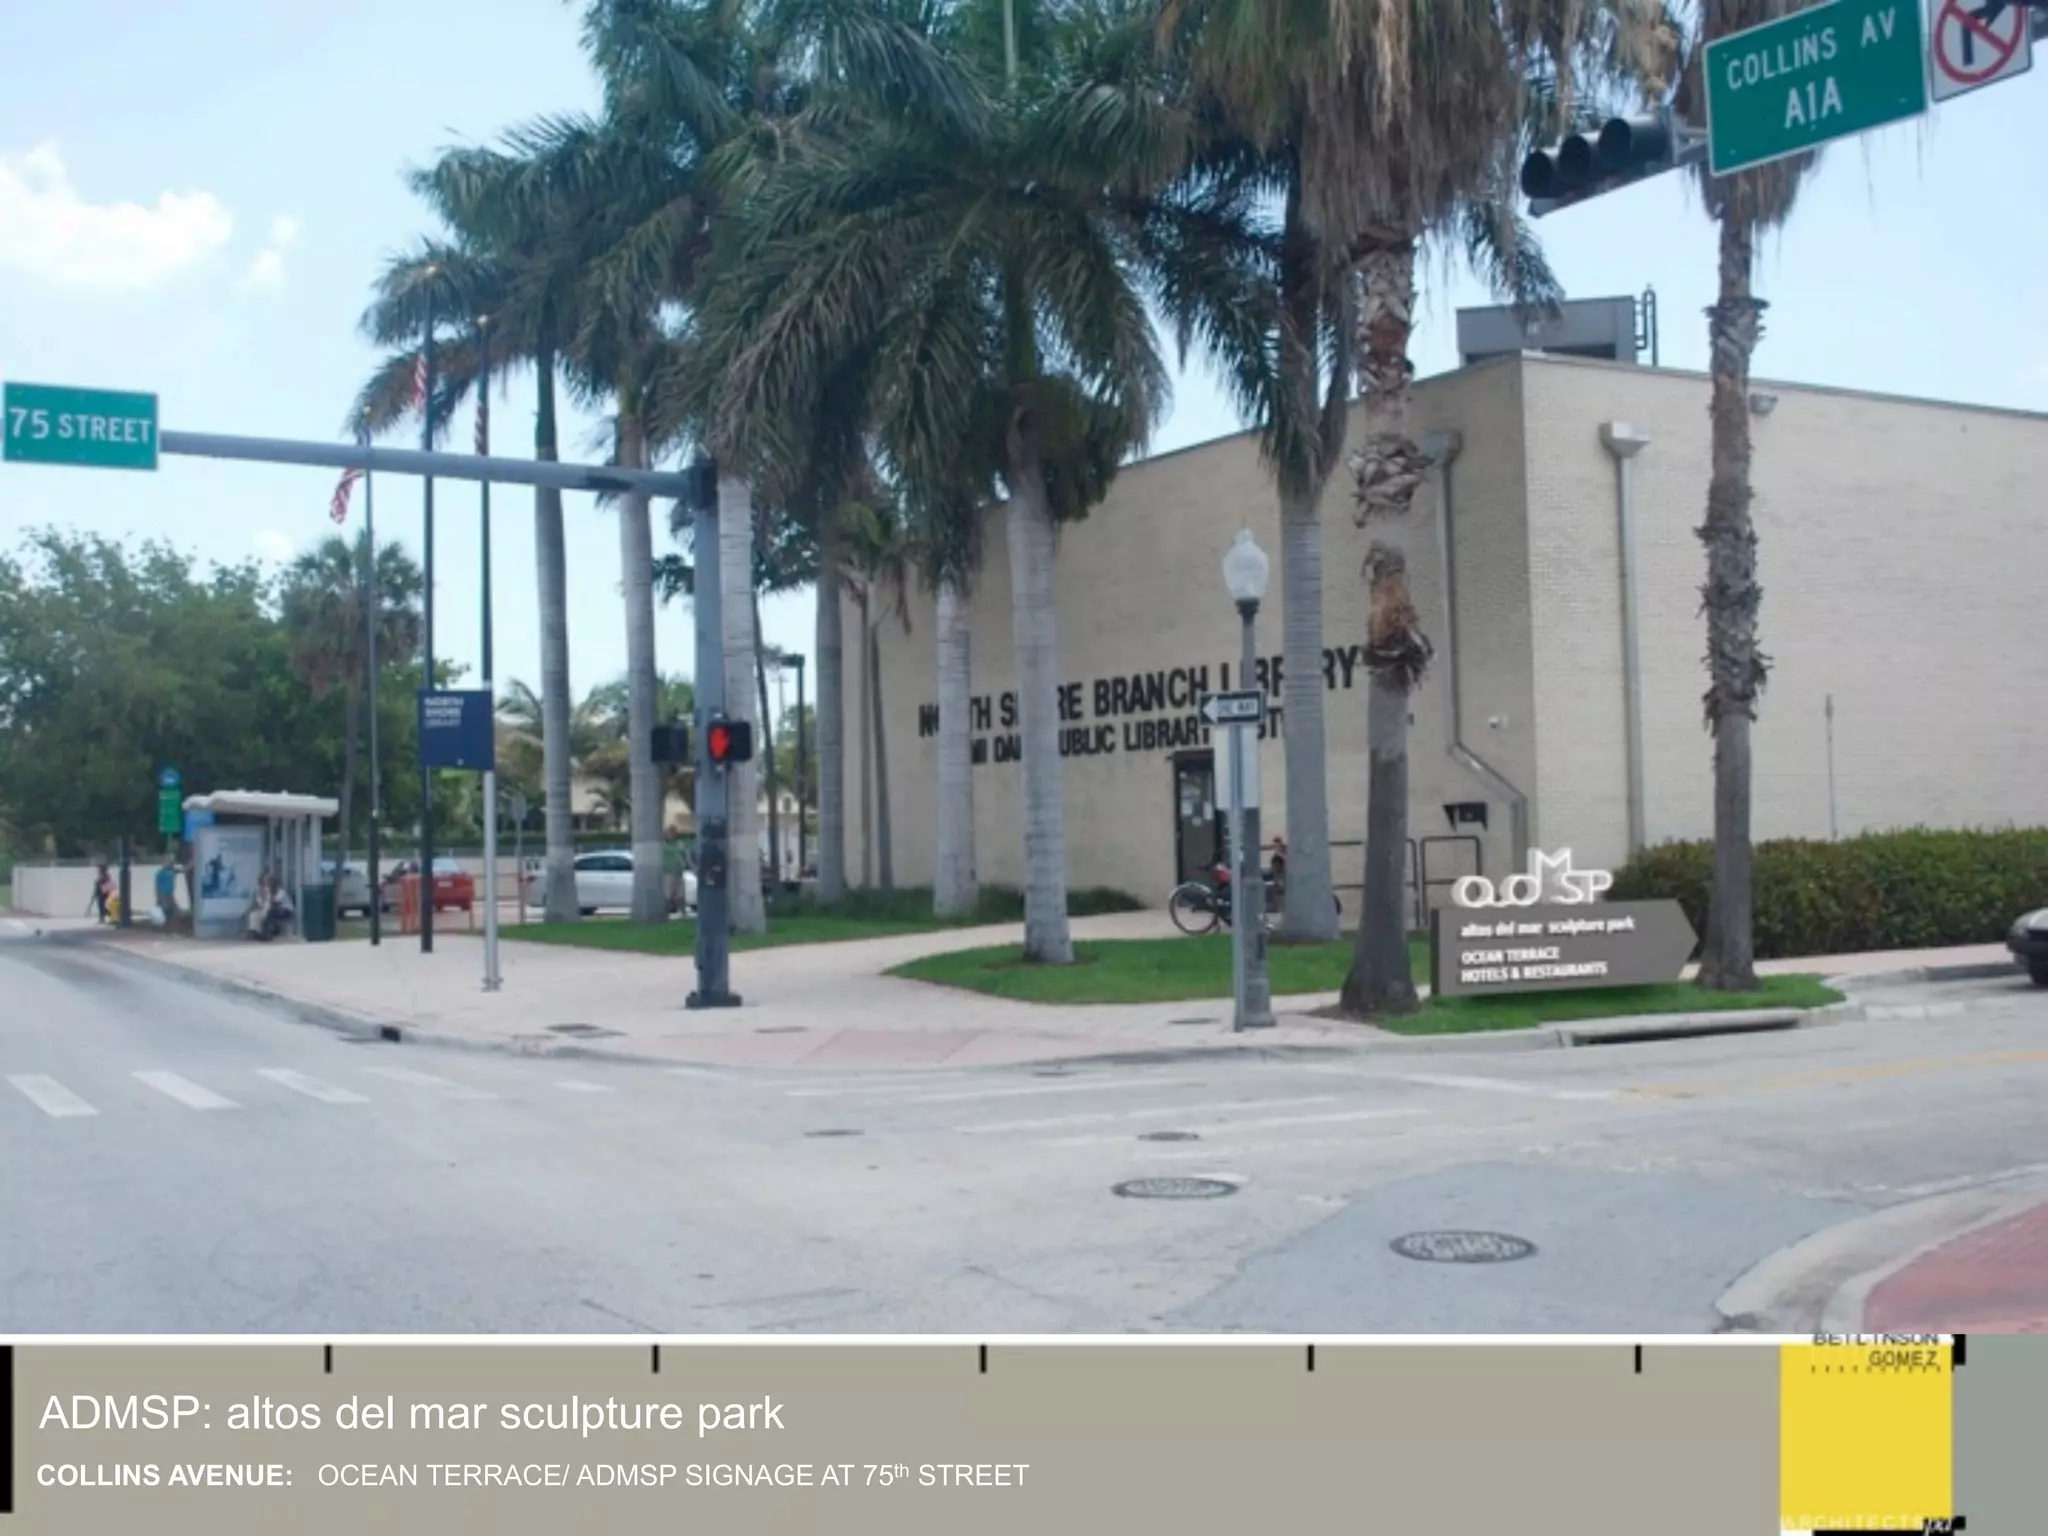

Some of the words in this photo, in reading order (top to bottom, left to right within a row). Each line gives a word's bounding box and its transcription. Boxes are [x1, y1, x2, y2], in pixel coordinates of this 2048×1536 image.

[1726, 27, 1838, 90] COLLINS
[1861, 7, 1896, 48] AV
[9, 407, 50, 440] 75
[57, 413, 152, 444] STREET
[918, 694, 991, 738] NTH
[1094, 664, 1208, 717] BRANCH
[1058, 723, 1116, 757] UBLIC
[1547, 917, 1605, 936] sculpture
[1606, 915, 1636, 934] park
[1461, 949, 1503, 964] OCEAN
[1506, 946, 1560, 962] TERRACE
[1461, 967, 1508, 982] HOTELS
[1523, 961, 1608, 980] RESTAURANTS
